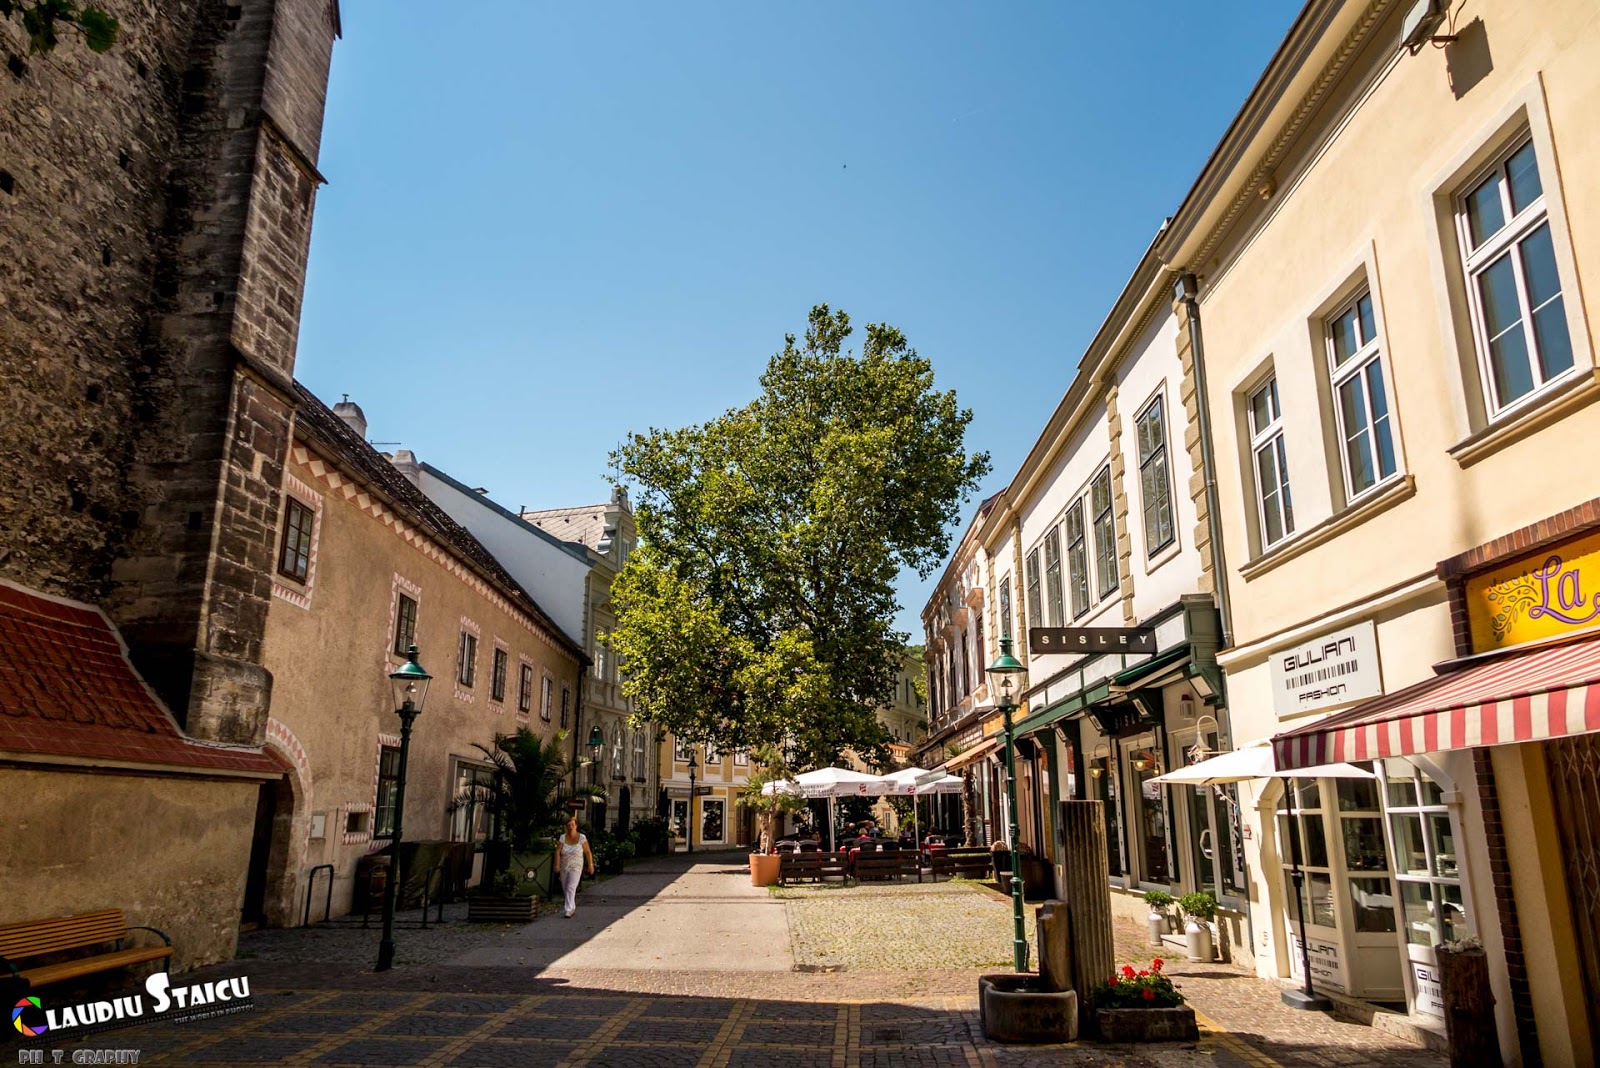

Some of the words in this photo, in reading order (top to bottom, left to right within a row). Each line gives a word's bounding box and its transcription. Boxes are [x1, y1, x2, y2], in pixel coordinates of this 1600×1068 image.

[1529, 555, 1594, 624] La
[1042, 635, 1148, 645] SISLEY
[1283, 636, 1356, 673] GIULIANI
[1298, 683, 1347, 703] FASHION
